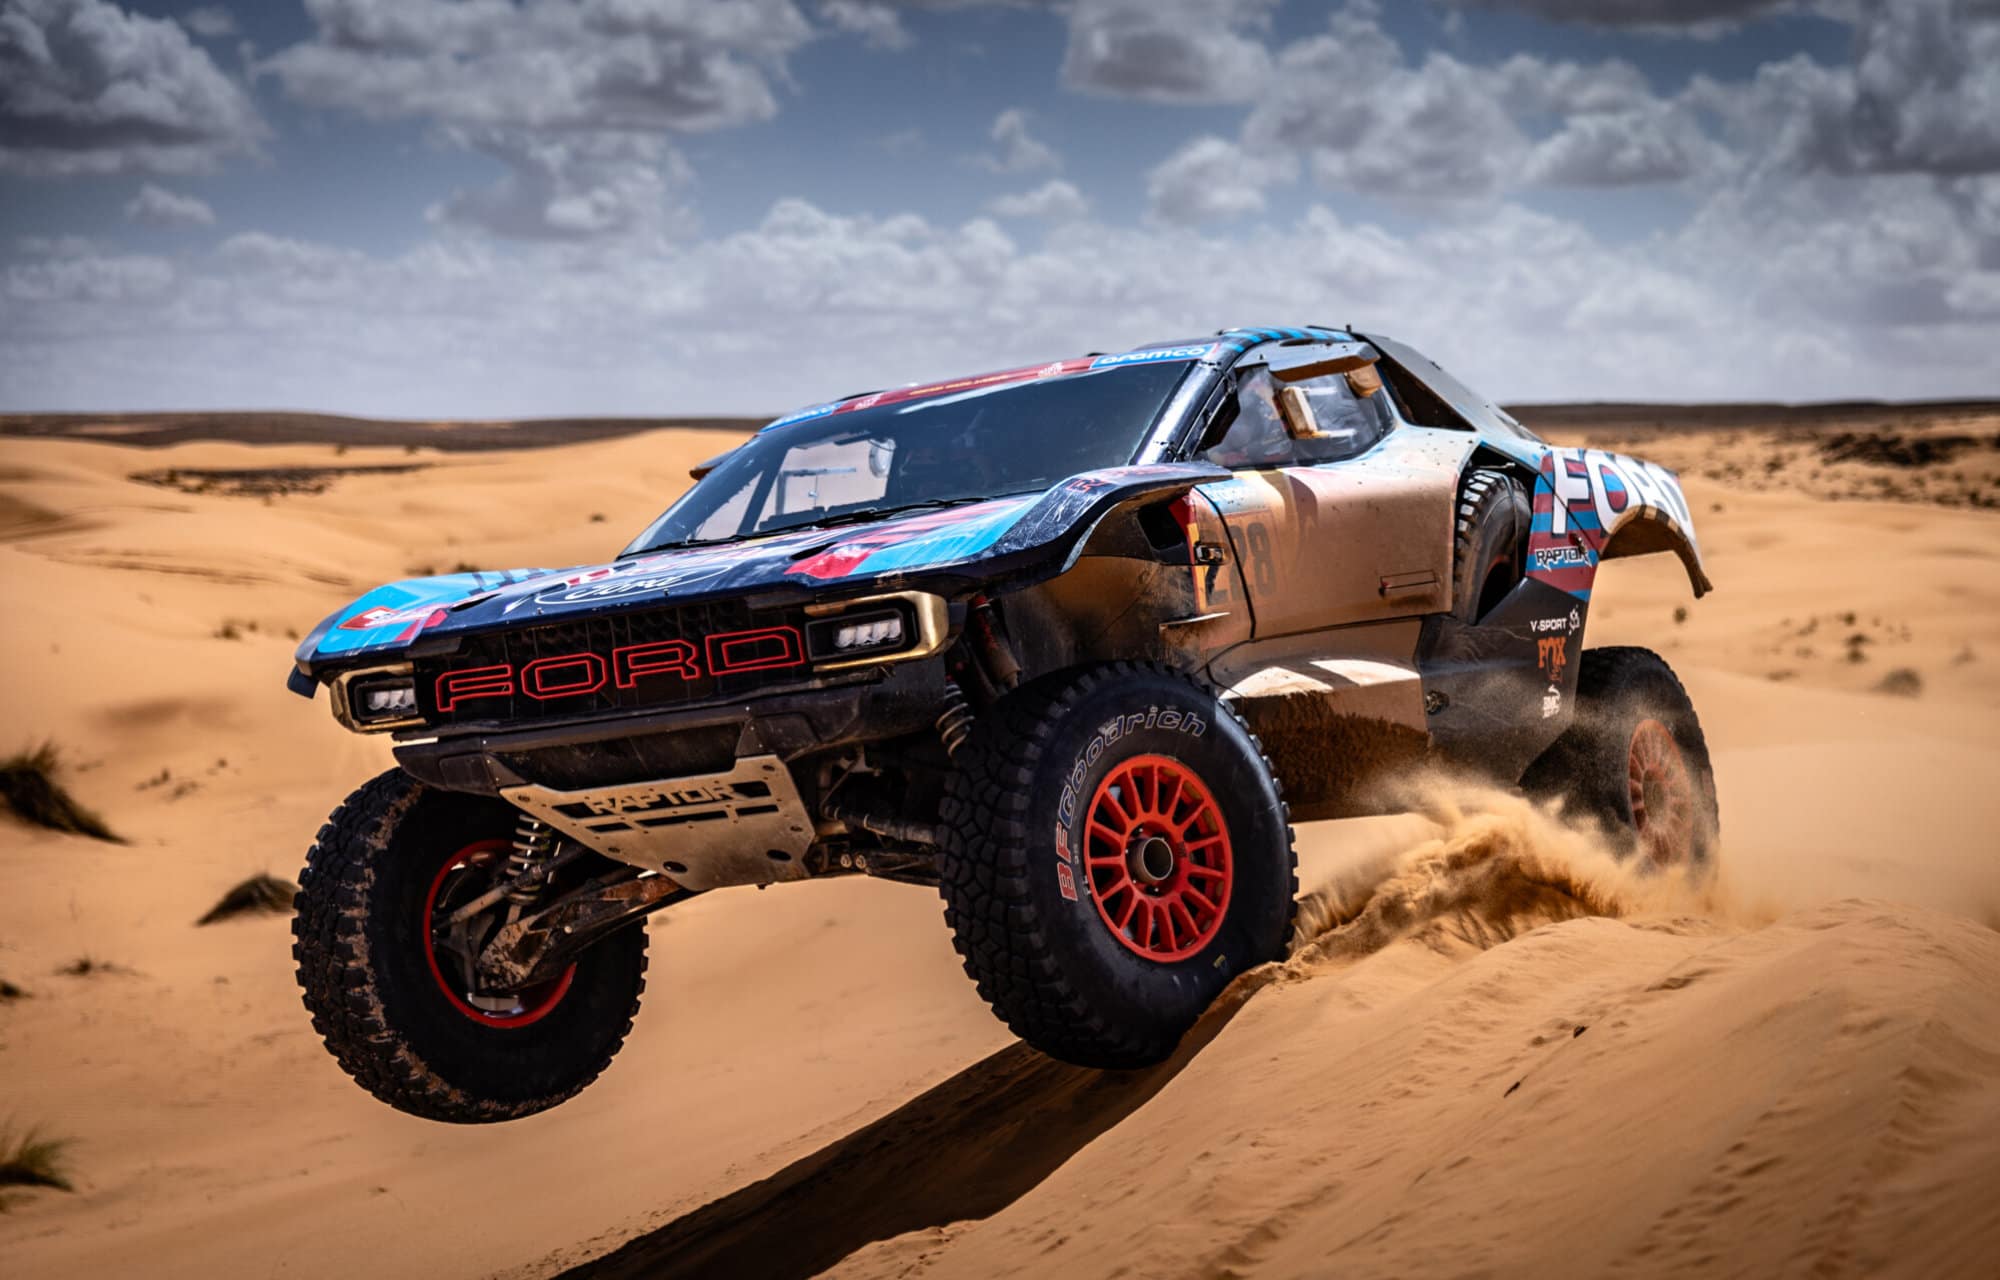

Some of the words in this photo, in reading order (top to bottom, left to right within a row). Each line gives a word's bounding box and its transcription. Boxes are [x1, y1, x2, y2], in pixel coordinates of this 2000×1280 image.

[1101, 347, 1206, 364] aramco
[1551, 447, 1696, 539] FORD
[1536, 547, 1592, 571] RAPTOR
[565, 576, 682, 600] Ford
[435, 626, 804, 712] FORD
[1537, 636, 1567, 672] FOX
[588, 782, 735, 815] RAPTOR
[1056, 706, 1207, 901] BFGoodrich
